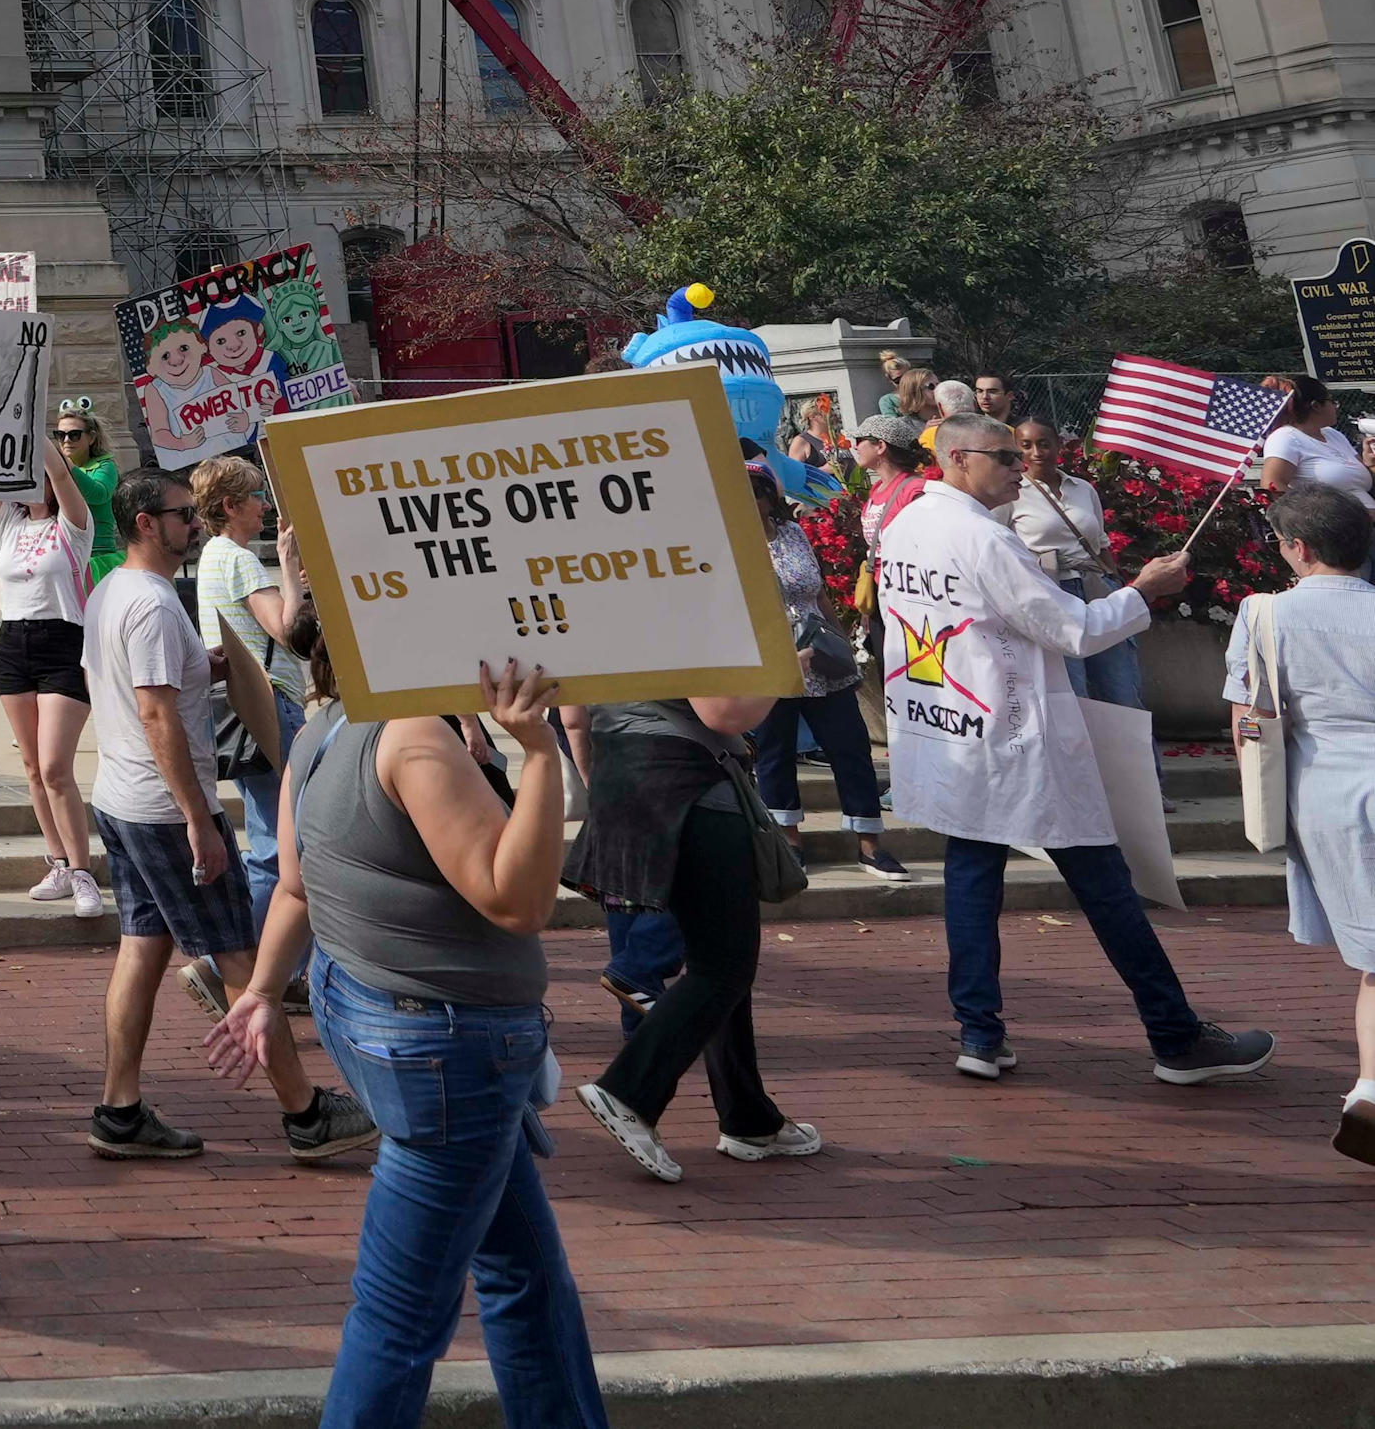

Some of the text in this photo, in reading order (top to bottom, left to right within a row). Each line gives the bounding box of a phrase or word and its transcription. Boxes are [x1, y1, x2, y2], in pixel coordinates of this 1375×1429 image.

[136, 246, 311, 333] DEMOCRACY
[1301, 281, 1369, 298] CIVIL WAR
[20, 321, 47, 345] NO
[286, 362, 310, 377] the
[286, 368, 349, 405] PEOPLE
[180, 379, 275, 431] POWER TO
[335, 428, 670, 497] BILLIONAIRES
[378, 471, 655, 535] LIVES OFF OF
[351, 535, 713, 601] US THE PEOPLE.
[996, 627, 1017, 661] SAVE
[908, 699, 984, 739] FASCISM
